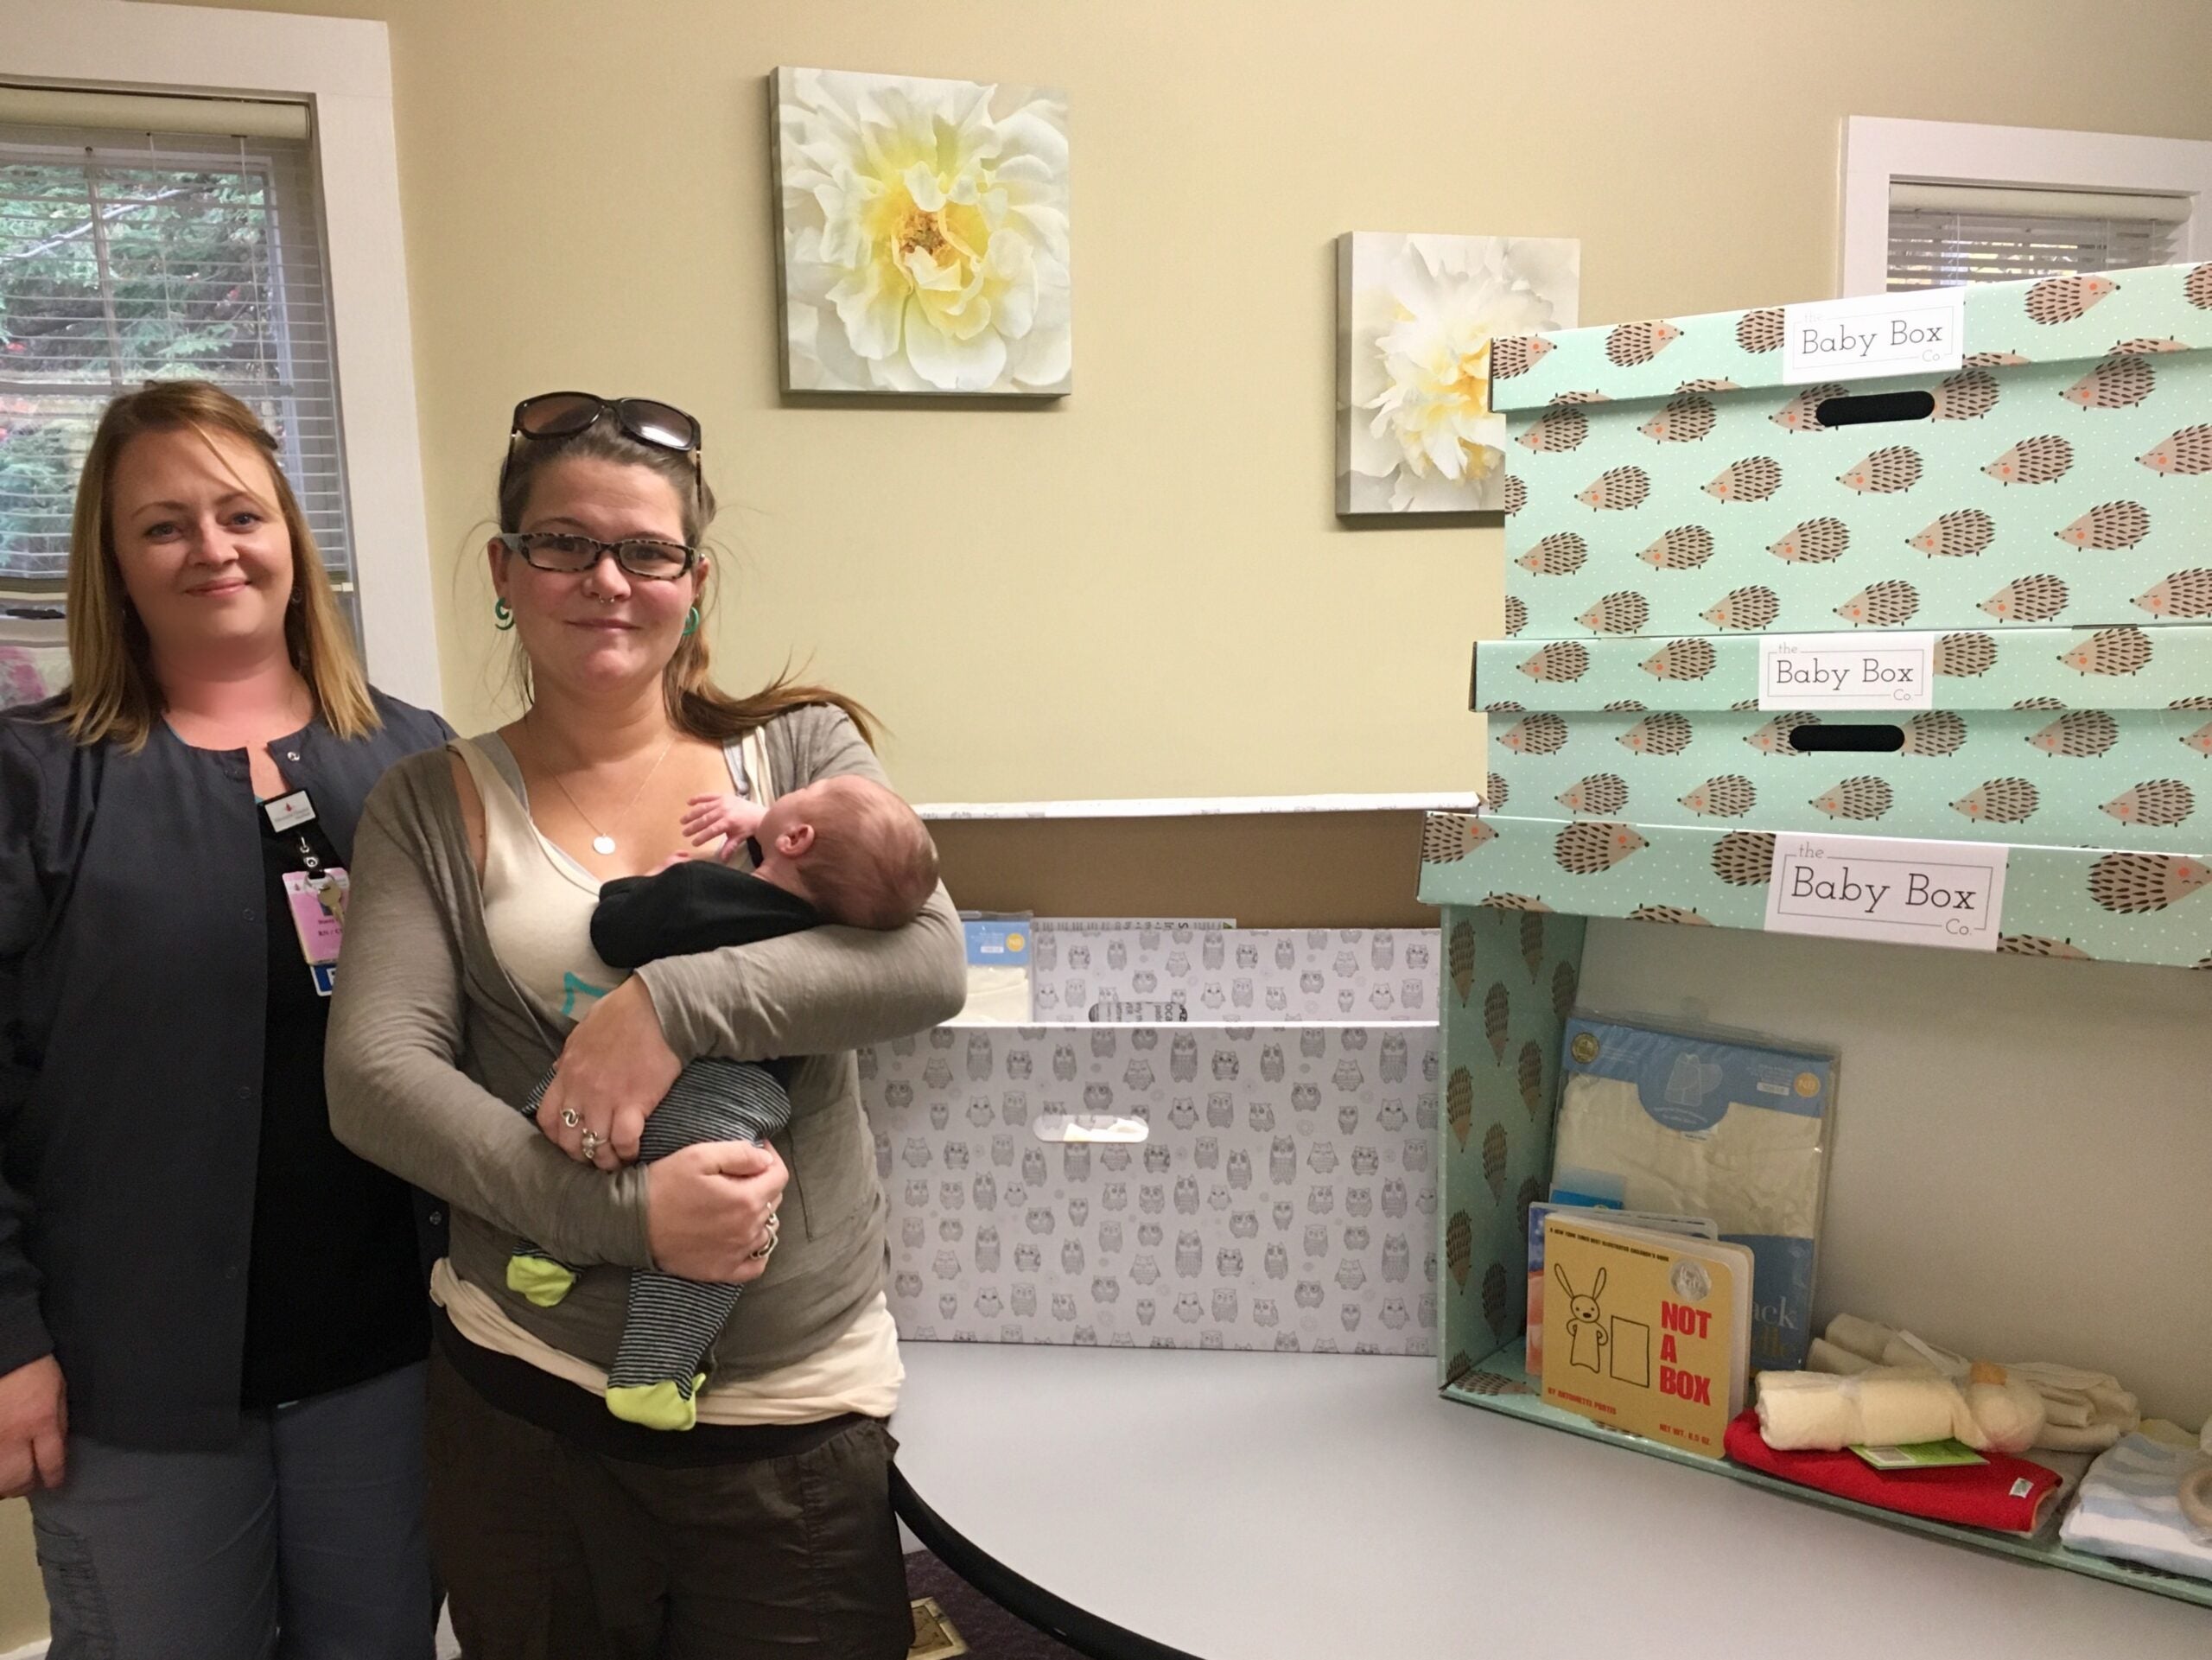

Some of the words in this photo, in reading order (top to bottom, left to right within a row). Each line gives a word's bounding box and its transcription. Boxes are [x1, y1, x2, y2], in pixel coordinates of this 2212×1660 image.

[1802, 324, 1878, 357] Baby
[1890, 320, 1943, 346] Box
[1778, 642, 1798, 654] the
[1777, 658, 1851, 691] Baby
[1862, 658, 1915, 683] Box
[1799, 842, 1825, 860] the
[1791, 865, 1891, 913] Baby
[1904, 873, 1977, 910] Box
[1945, 918, 1973, 936] Co.
[1661, 1301, 1712, 1339] NOT
[1660, 1333, 1677, 1364] A
[1659, 1364, 1711, 1407] BOX
[1659, 1423, 1671, 1434] NET
